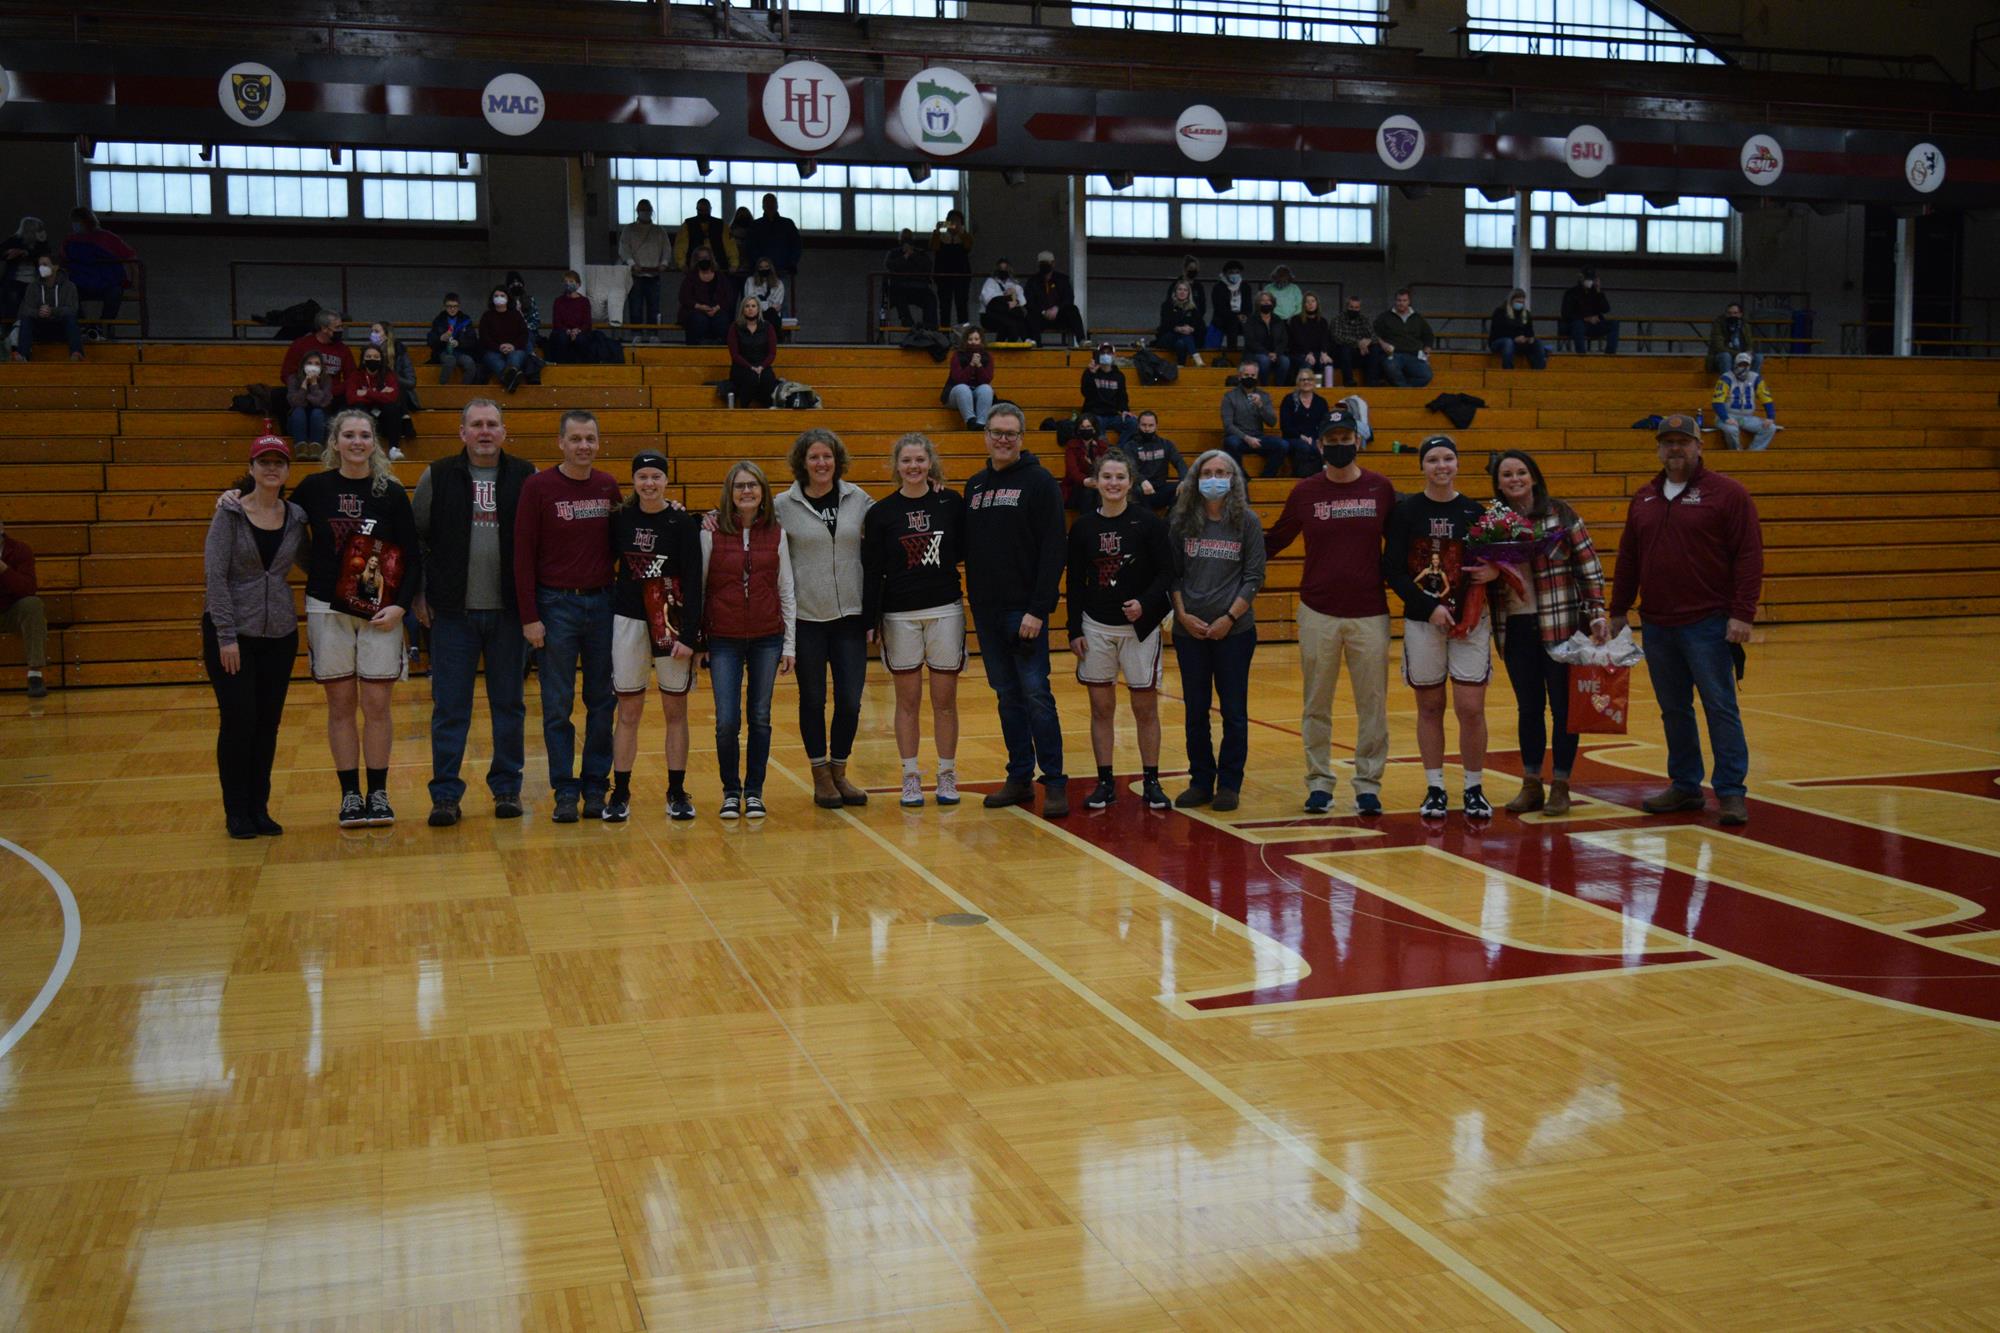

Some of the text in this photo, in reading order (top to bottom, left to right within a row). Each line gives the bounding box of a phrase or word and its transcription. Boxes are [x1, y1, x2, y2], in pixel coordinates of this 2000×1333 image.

[242, 82, 260, 102] G
[488, 94, 539, 114] MAC
[780, 77, 836, 139] HU
[1572, 142, 1604, 160] SJU
[1730, 385, 1753, 410] 11
[1578, 679, 1601, 693] WE
